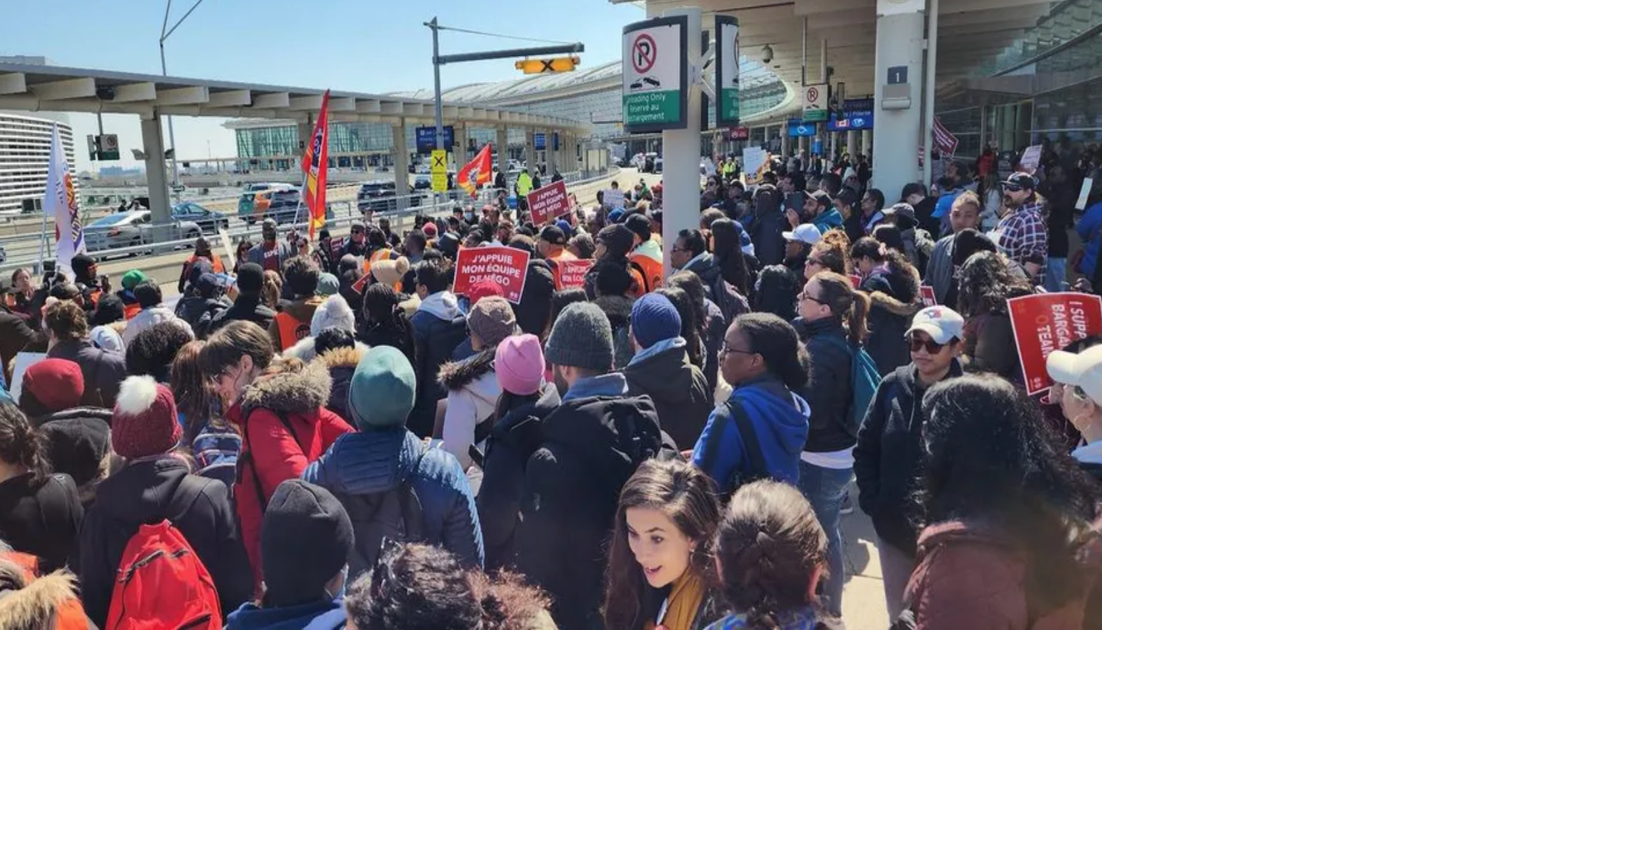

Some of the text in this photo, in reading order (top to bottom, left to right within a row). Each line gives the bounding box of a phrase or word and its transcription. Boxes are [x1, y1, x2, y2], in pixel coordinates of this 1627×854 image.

[895, 72, 900, 82] 1
[650, 93, 666, 102] Only
[472, 254, 513, 265] J'APPUIE
[461, 262, 521, 278] MON ÉQUIPE
[469, 275, 482, 283] DE
[1051, 304, 1072, 348] BARGAI
[1070, 308, 1087, 339] SUPP
